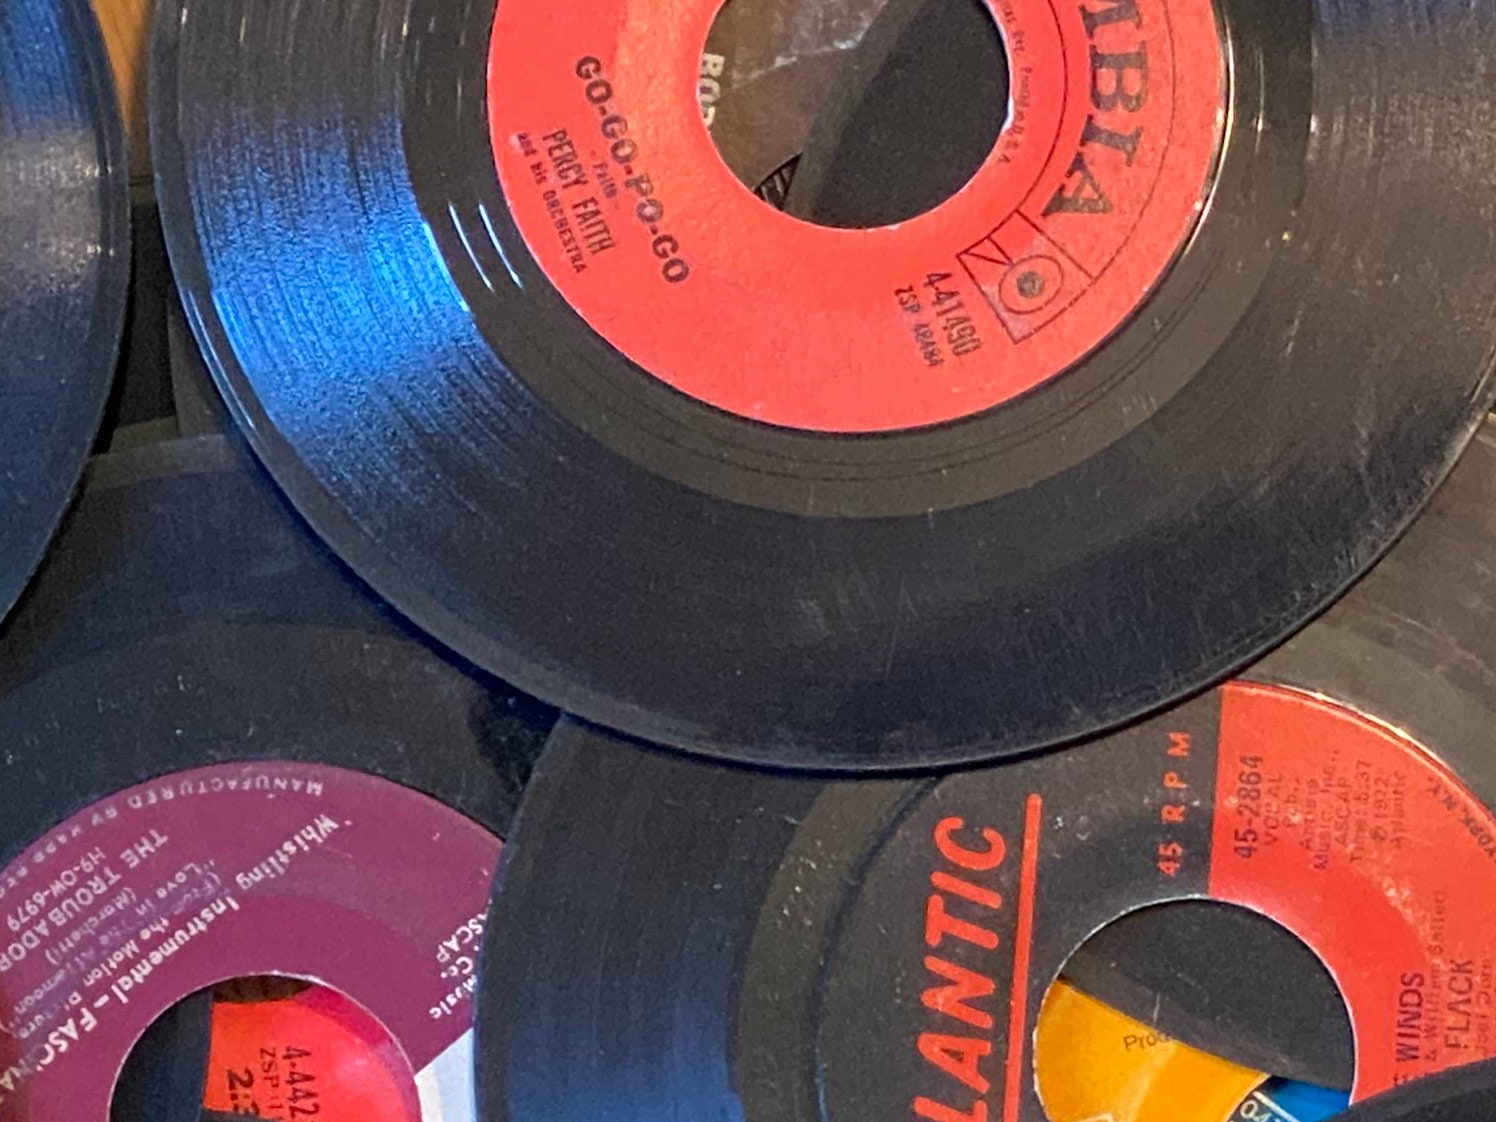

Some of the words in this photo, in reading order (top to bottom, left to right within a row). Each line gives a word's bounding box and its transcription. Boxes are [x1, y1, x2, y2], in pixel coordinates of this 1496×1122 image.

[542, 128, 589, 190] PERCY
[572, 197, 615, 256] FAITH
[575, 56, 690, 284] GO-GO-PO-GO
[542, 190, 587, 274] ORCHESTRA
[119, 828, 170, 869] THE
[1233, 754, 1265, 861] 45-2864
[235, 814, 339, 891] Whistling
[1156, 841, 1184, 878] 45
[82, 937, 141, 987] Motion
[111, 896, 241, 1005] Instrumental
[139, 916, 171, 942] the
[1395, 971, 1426, 1063] WINDS
[1443, 958, 1475, 1051] FLACK
[260, 1047, 280, 1088] ZSP
